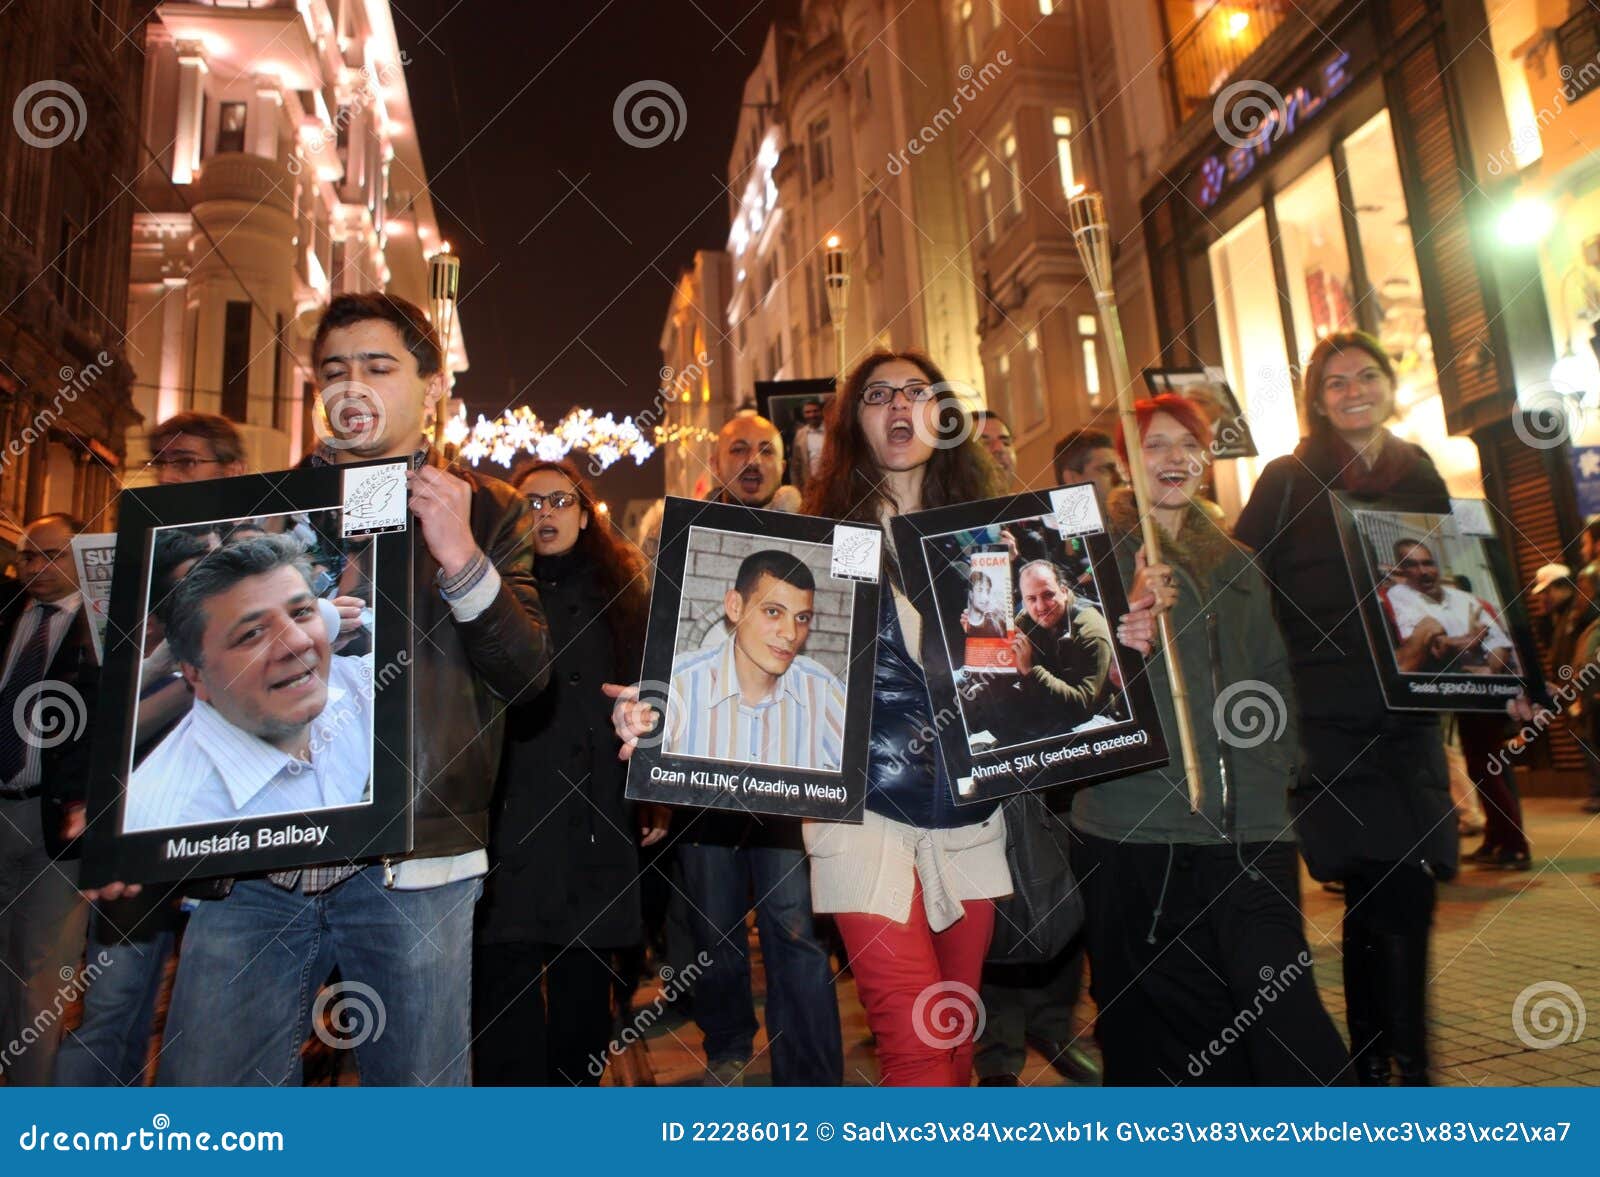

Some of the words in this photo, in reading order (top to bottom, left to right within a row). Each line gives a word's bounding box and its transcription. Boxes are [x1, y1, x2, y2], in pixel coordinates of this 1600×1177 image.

[970, 761, 1012, 779] Ahmet
[1014, 753, 1039, 773] ŞIK
[1040, 743, 1091, 768] (serbest
[1093, 729, 1148, 755] gazeteci)
[650, 766, 686, 783] Ozan
[690, 770, 739, 792] KILINÇ
[742, 776, 800, 797] (Azadiya
[804, 783, 847, 802] Welat)
[165, 831, 250, 859] Mustafa
[256, 824, 329, 848] Balbay
